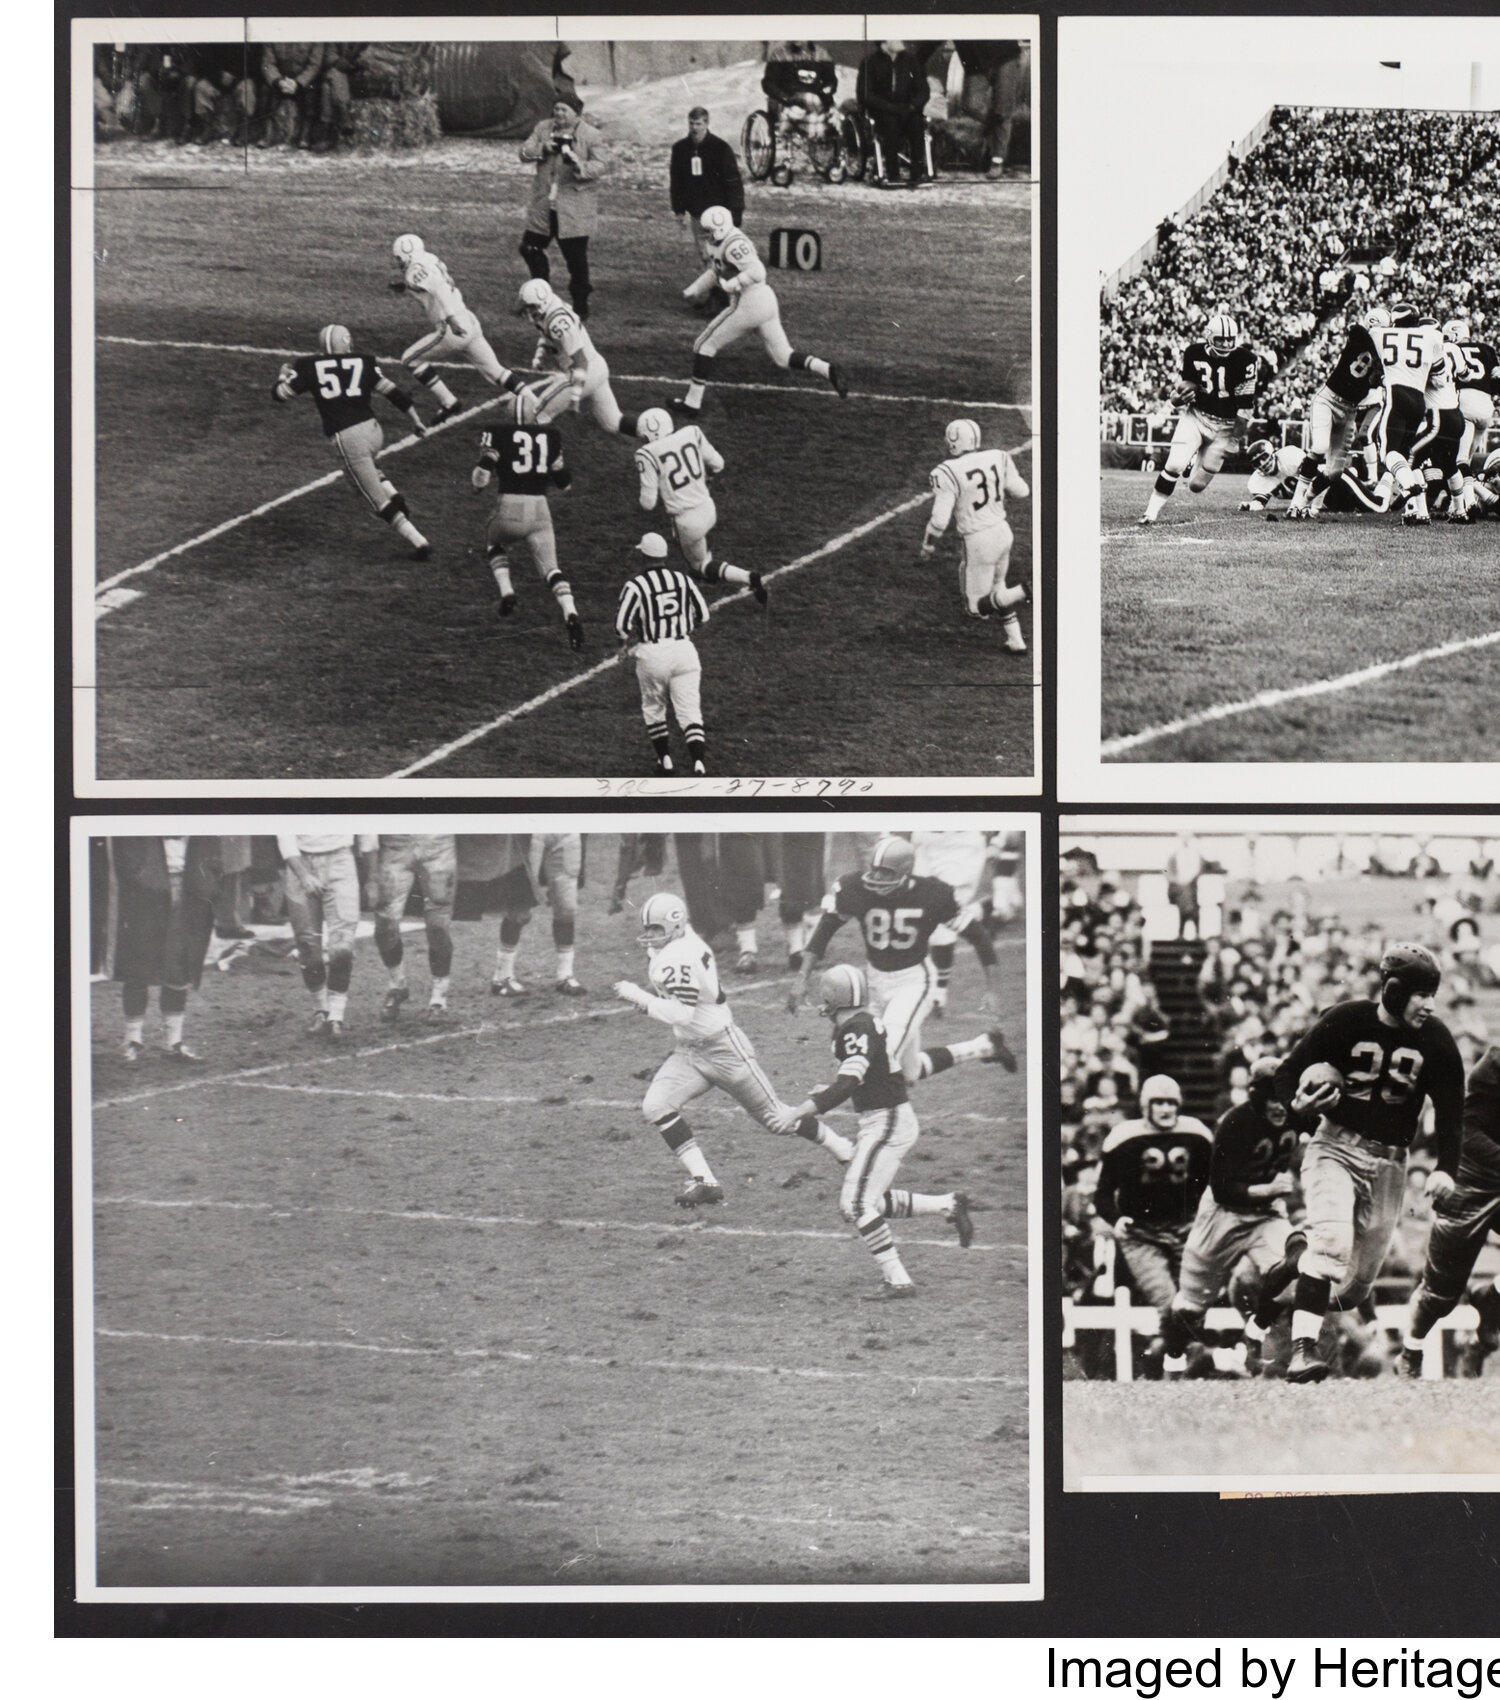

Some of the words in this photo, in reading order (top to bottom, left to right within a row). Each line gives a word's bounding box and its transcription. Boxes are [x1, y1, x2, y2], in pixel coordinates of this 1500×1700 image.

[730, 243, 750, 261] 66
[779, 231, 818, 271] 10
[551, 318, 571, 339] 53
[1382, 332, 1424, 369] 55
[314, 357, 364, 400] 57
[1193, 360, 1230, 399] 31
[512, 430, 549, 474] 31
[659, 442, 702, 491] 20
[1141, 459, 1155, 473] 10
[965, 464, 1001, 511] 31
[655, 591, 680, 617] 5
[865, 908, 924, 950] 85
[662, 965, 691, 985] 25
[843, 1032, 869, 1055] 24
